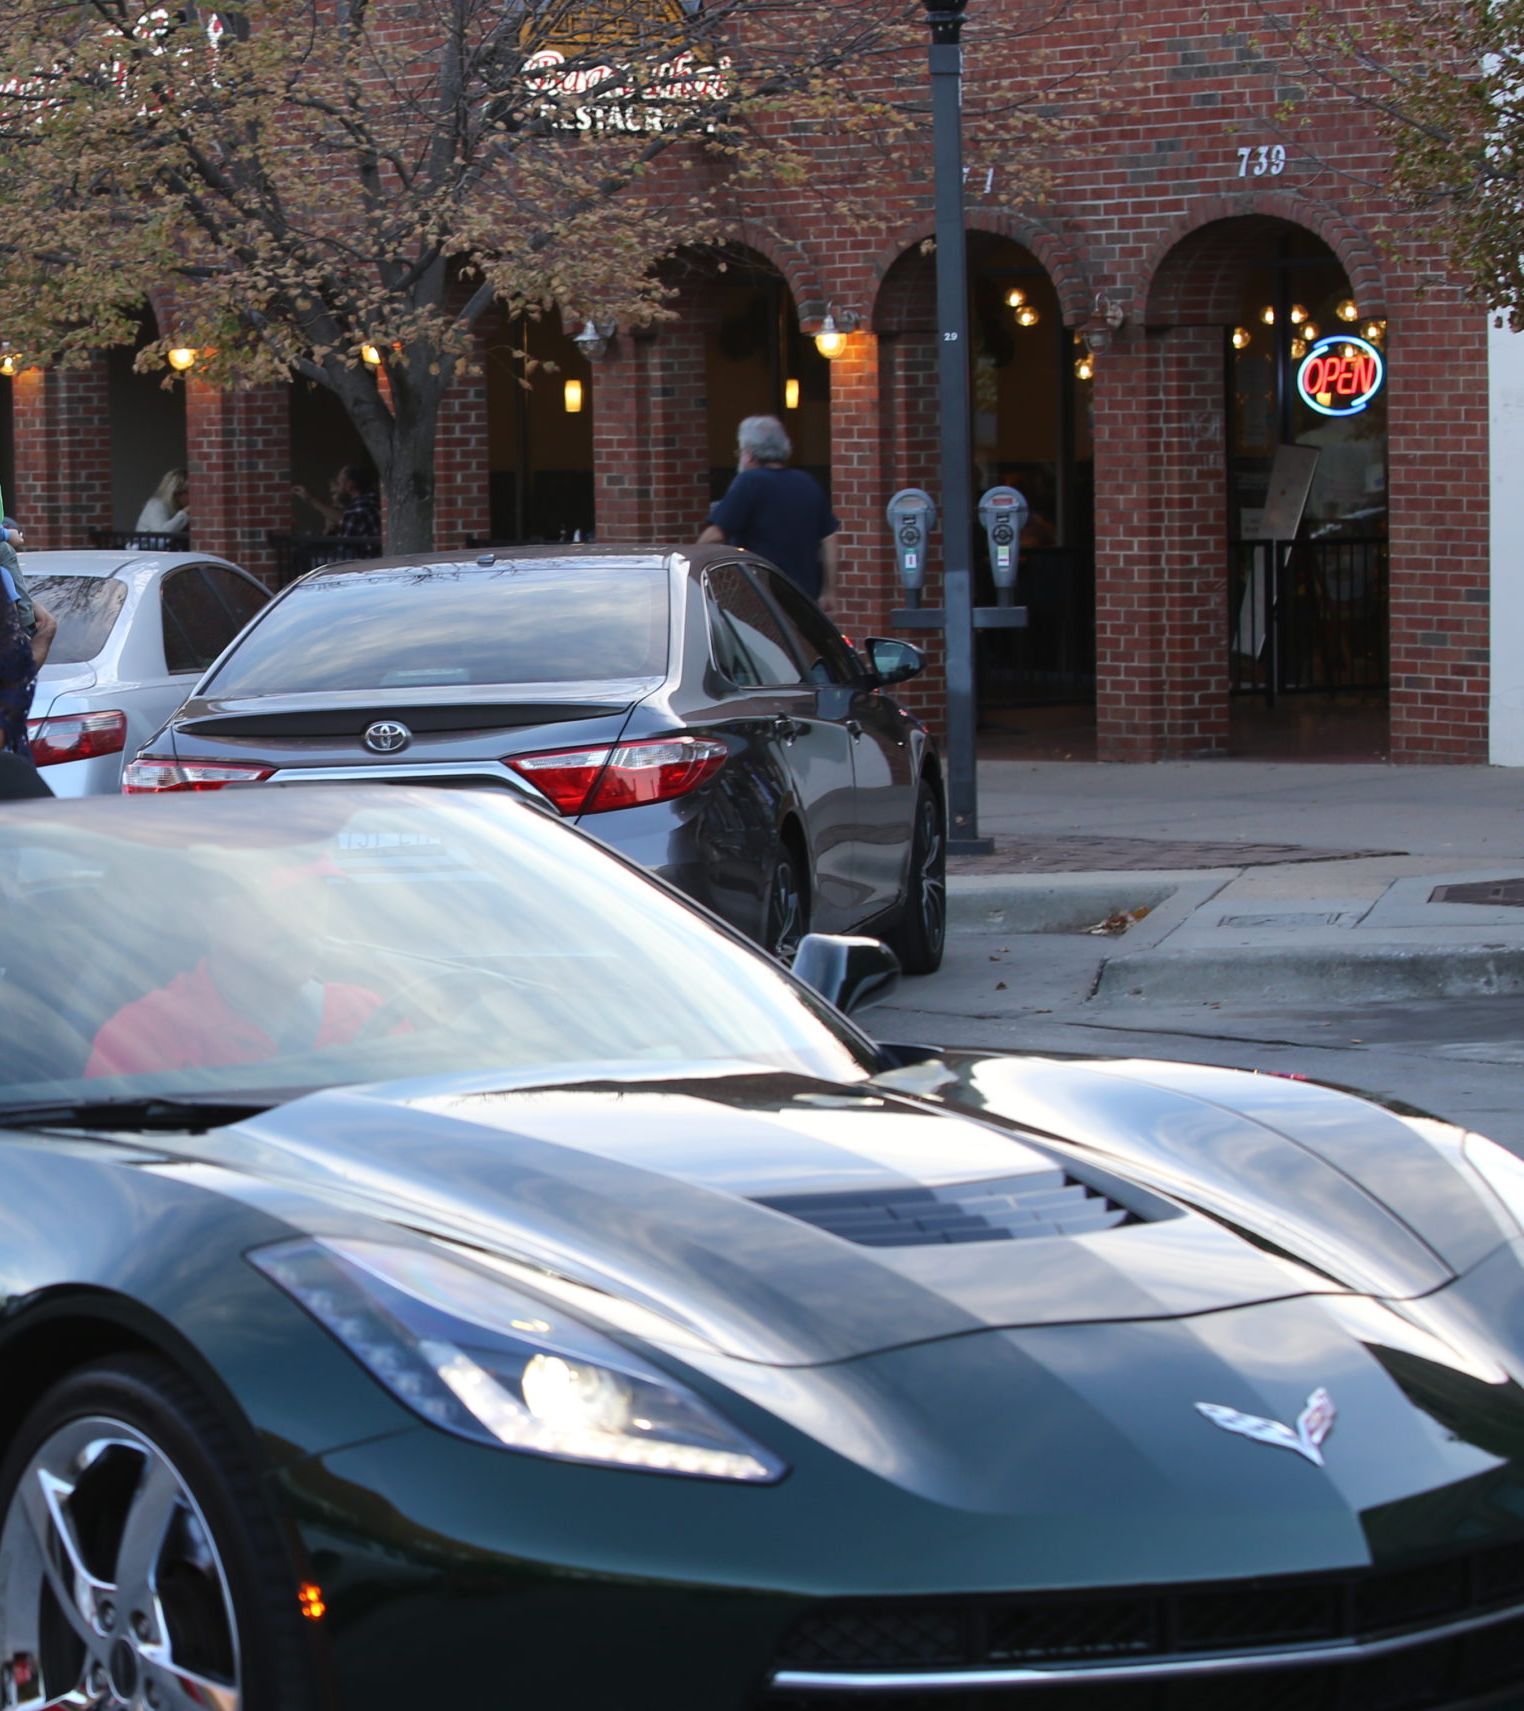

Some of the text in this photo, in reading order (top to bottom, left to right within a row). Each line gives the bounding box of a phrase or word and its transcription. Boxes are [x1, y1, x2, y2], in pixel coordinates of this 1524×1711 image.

[538, 101, 718, 134] ESTAUR
[1237, 144, 1286, 178] 739
[943, 331, 958, 342] 29
[1303, 355, 1376, 395] OPEN
